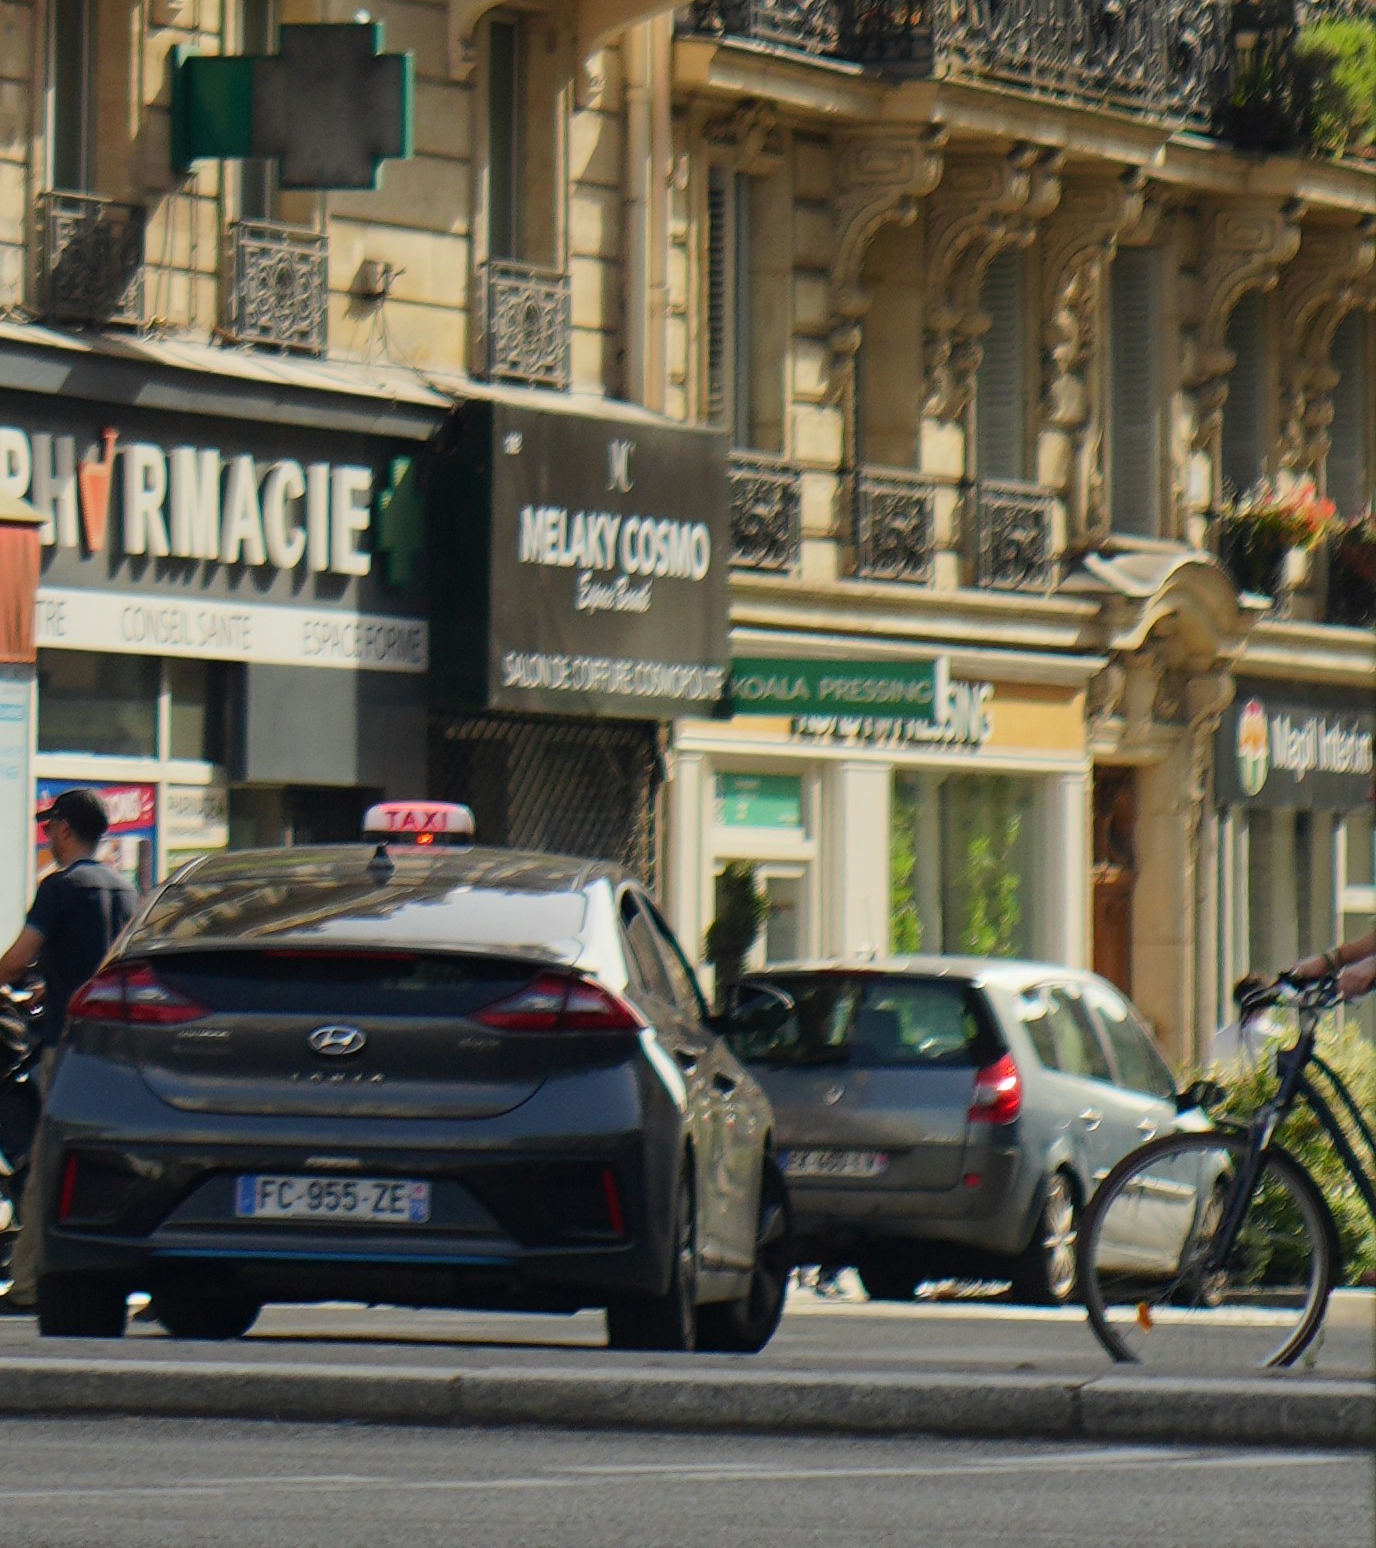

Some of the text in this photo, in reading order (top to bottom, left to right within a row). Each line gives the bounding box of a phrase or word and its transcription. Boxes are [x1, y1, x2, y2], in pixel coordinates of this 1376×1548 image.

[519, 505, 711, 582] MELAKY COSMO
[120, 605, 193, 647] CONSEIL
[732, 675, 934, 705] KOALA PRESSING
[385, 810, 448, 832] TAXI
[257, 1179, 405, 1214] FC-955-ZE
